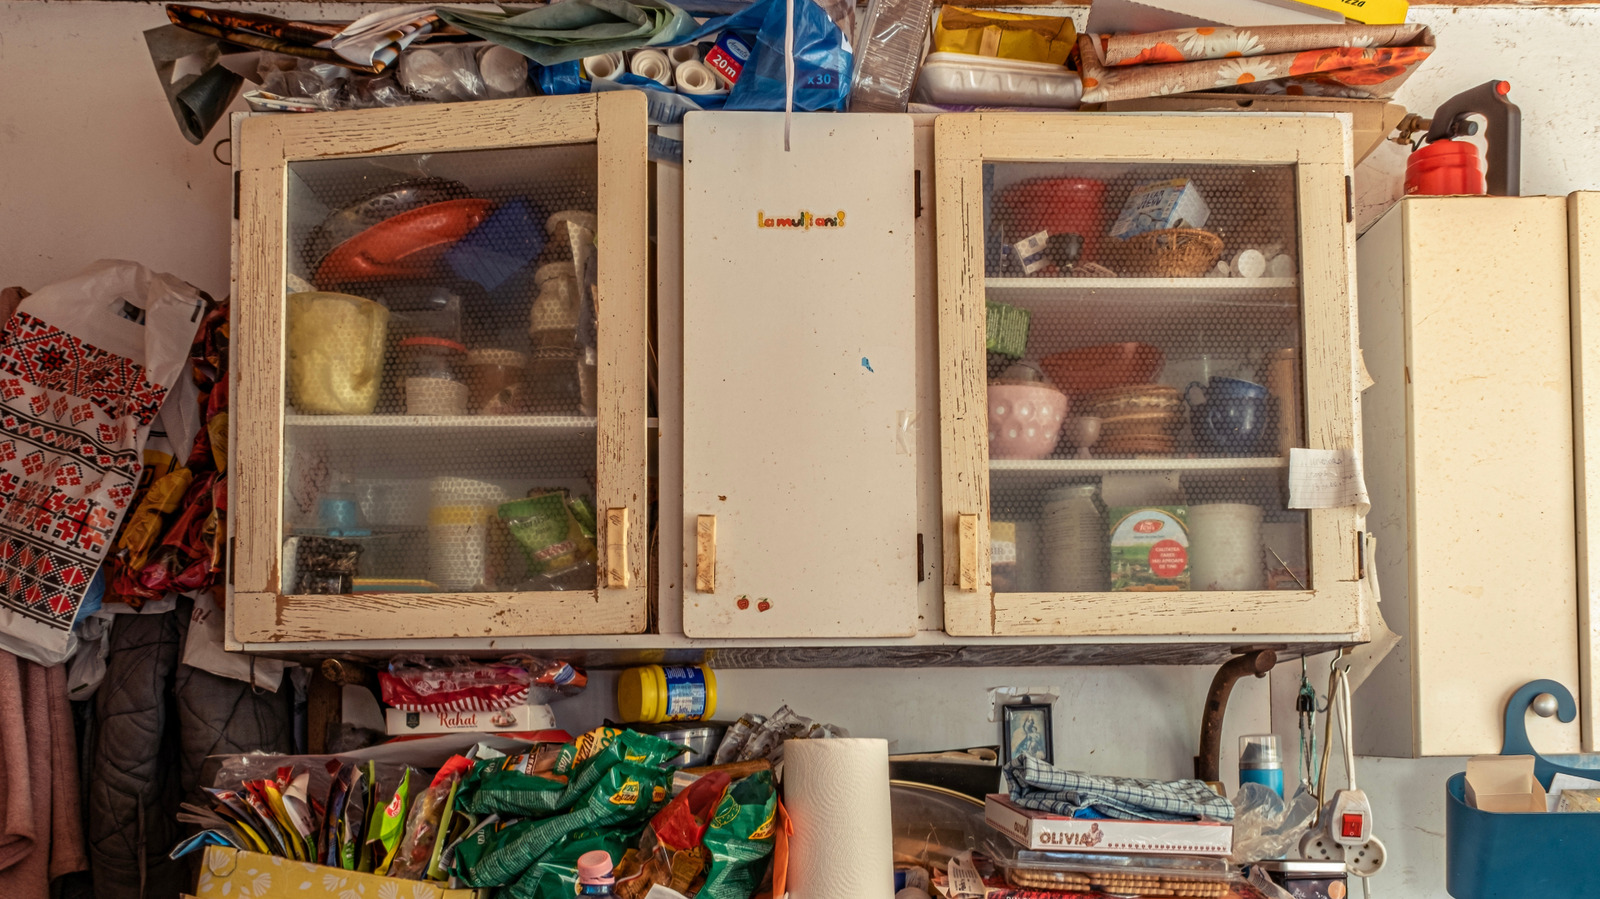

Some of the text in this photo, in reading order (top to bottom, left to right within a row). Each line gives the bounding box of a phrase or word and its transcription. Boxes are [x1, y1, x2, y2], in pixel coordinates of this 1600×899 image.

[712, 54, 728, 69] 20
[758, 211, 775, 228] La
[815, 211, 846, 227] ani!
[437, 711, 478, 728] Rahat
[1039, 831, 1088, 846] OLIVIA
